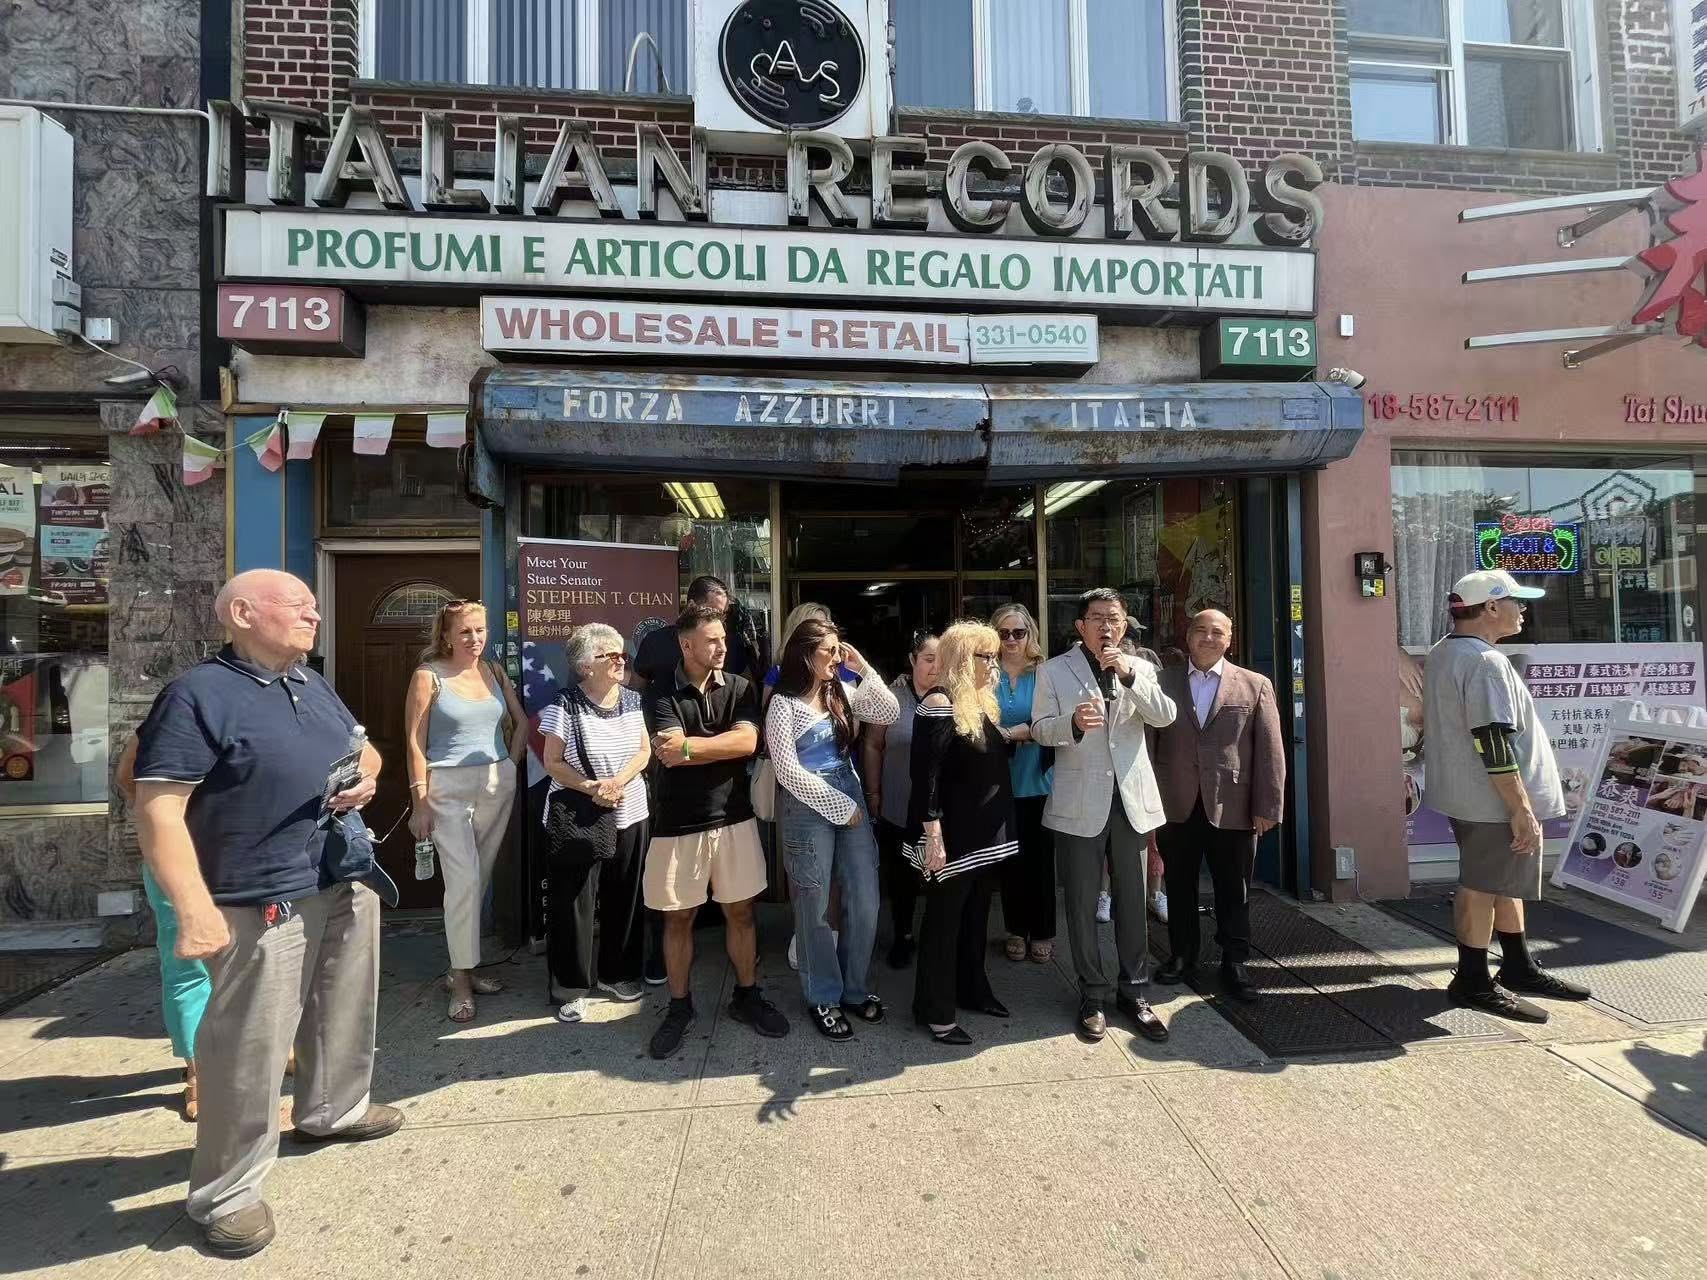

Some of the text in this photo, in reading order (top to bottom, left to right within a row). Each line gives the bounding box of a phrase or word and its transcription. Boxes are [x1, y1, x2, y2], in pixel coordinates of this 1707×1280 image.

[207, 100, 1324, 246] ITALIAN RECORDS
[288, 228, 1263, 299] PROFUMI E ARTICOLI DA REGALO IMPORTATI
[228, 295, 331, 331] 7113
[976, 324, 1088, 345] 331-0540
[1228, 327, 1311, 357] 7113
[563, 388, 1196, 428] FORZA AZZURRI ITALIA
[1368, 393, 1520, 422] 18-587-2111
[1623, 394, 1707, 424] Tai Shu
[1500, 537, 1541, 553] FOOT
[526, 556, 588, 570] Meet Your
[1495, 553, 1559, 570] BACK RUB
[527, 573, 603, 587] State Senator
[526, 589, 674, 607] STEPHEN T. CHAN
[527, 608, 572, 623] 陳學理
